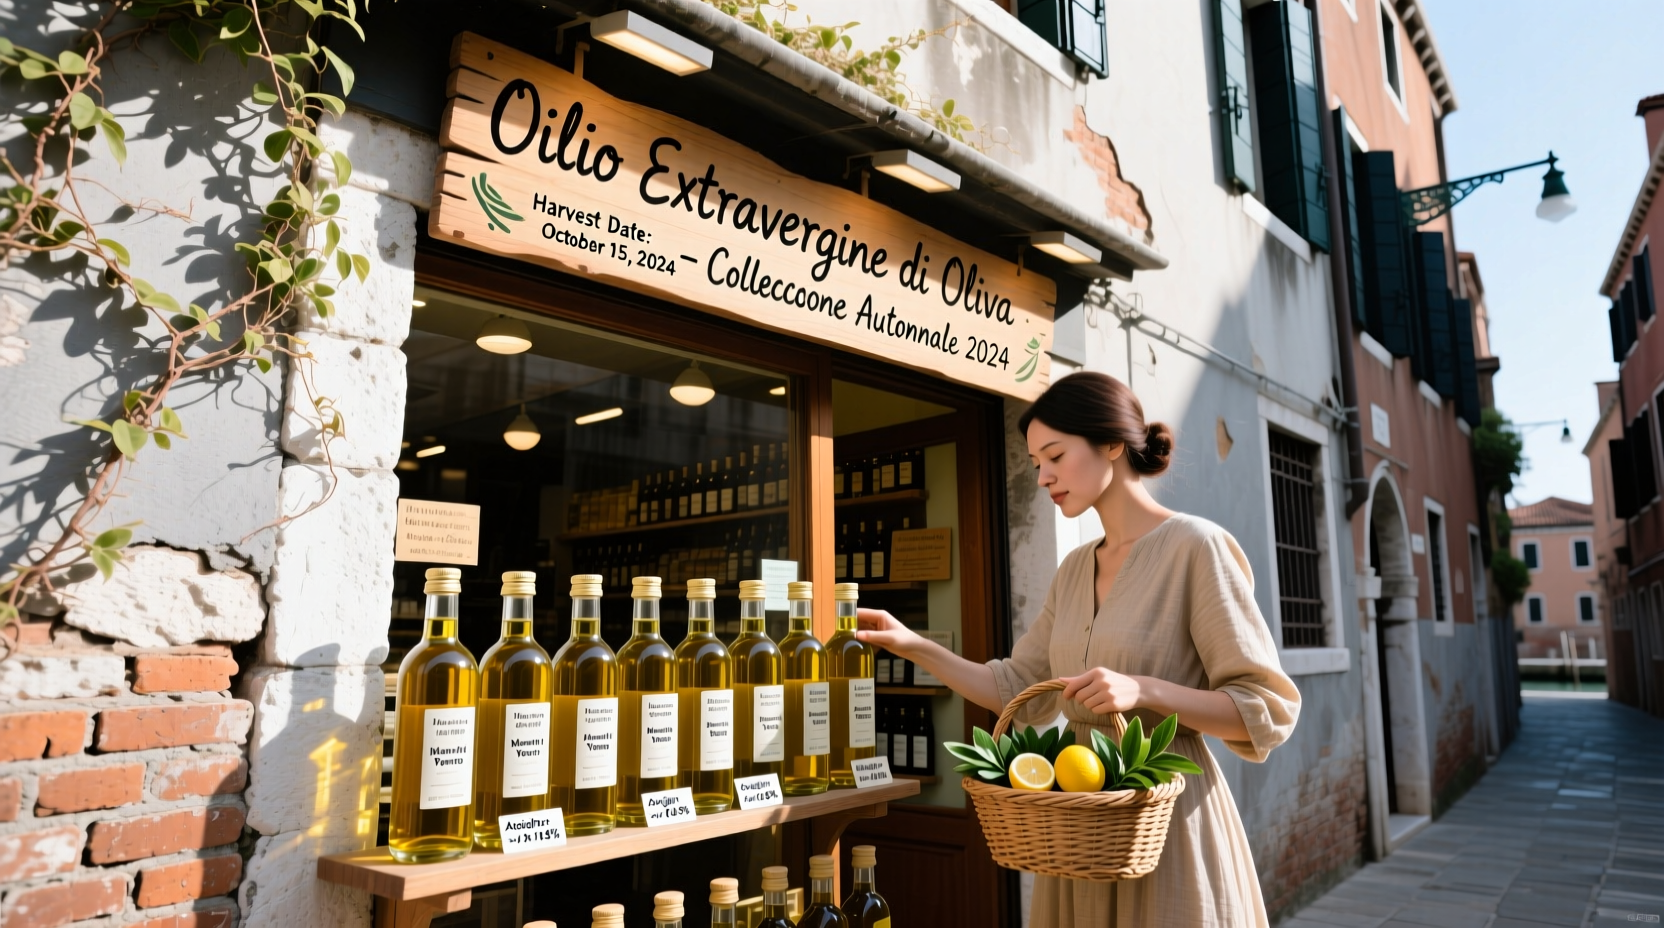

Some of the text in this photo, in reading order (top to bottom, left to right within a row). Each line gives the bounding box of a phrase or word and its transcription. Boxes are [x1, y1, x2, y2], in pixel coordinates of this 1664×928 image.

[490, 78, 1015, 326] Oilio Extravergine di Oliva
[532, 192, 653, 244] Harvest Date:
[541, 222, 677, 277] October 15, 2024
[965, 336, 1010, 371] 2024
